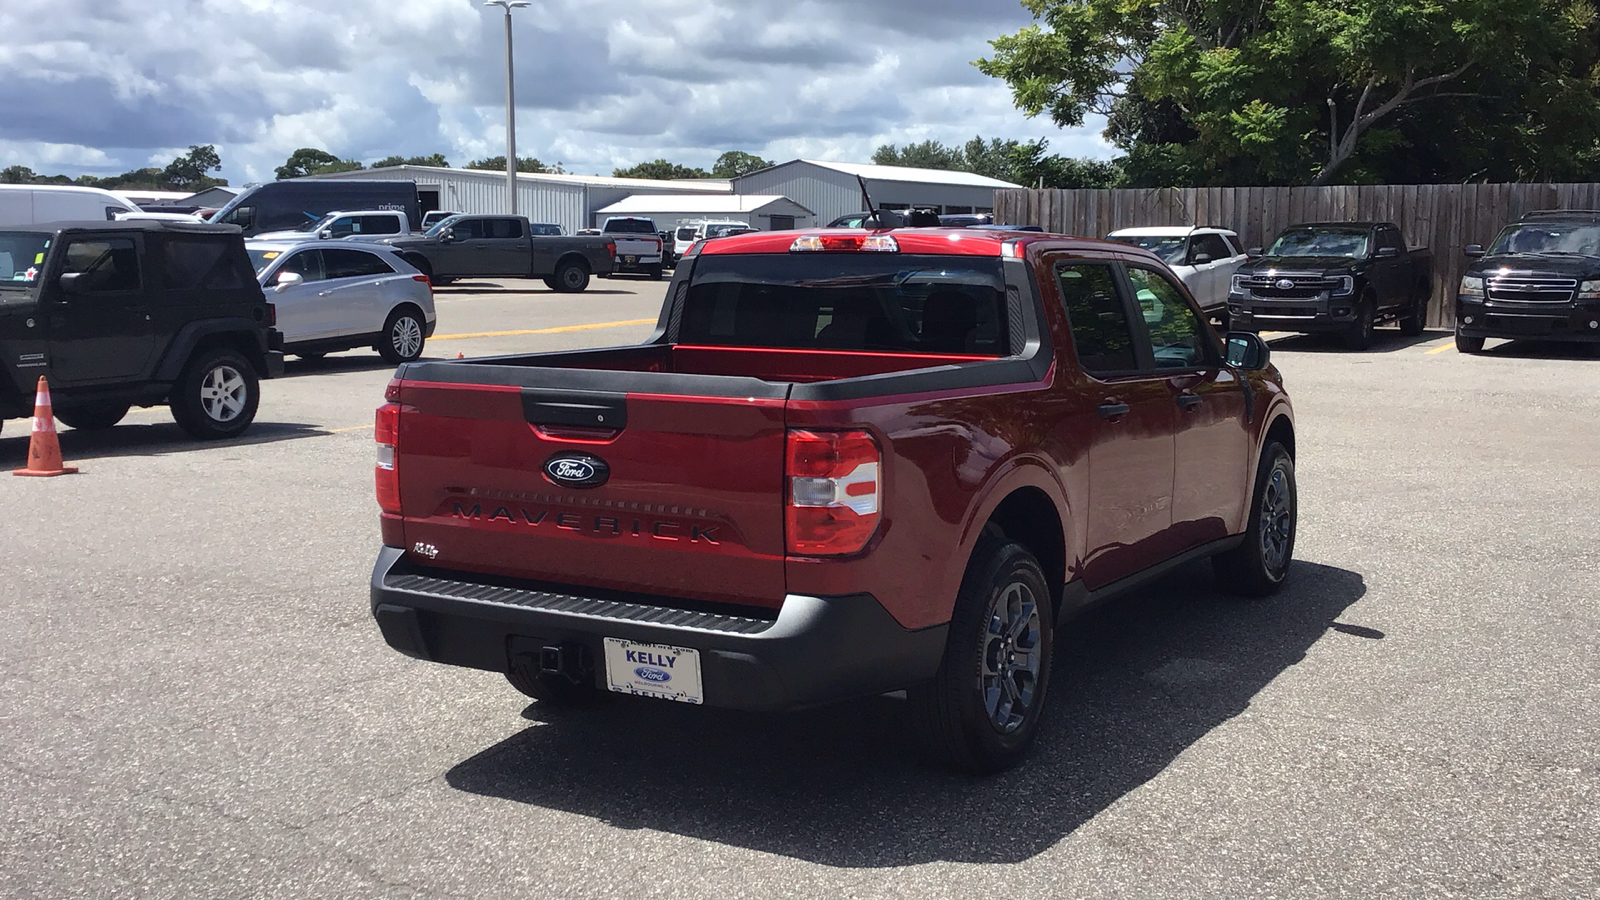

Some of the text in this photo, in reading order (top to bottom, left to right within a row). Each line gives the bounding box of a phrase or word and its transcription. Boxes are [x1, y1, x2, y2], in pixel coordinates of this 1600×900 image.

[378, 202, 405, 211] prime
[556, 461, 585, 478] Ford
[452, 501, 721, 545] MAVERICK
[625, 649, 677, 668] KELLY
[640, 668, 664, 681] Ford
[630, 689, 678, 701] KELLY
